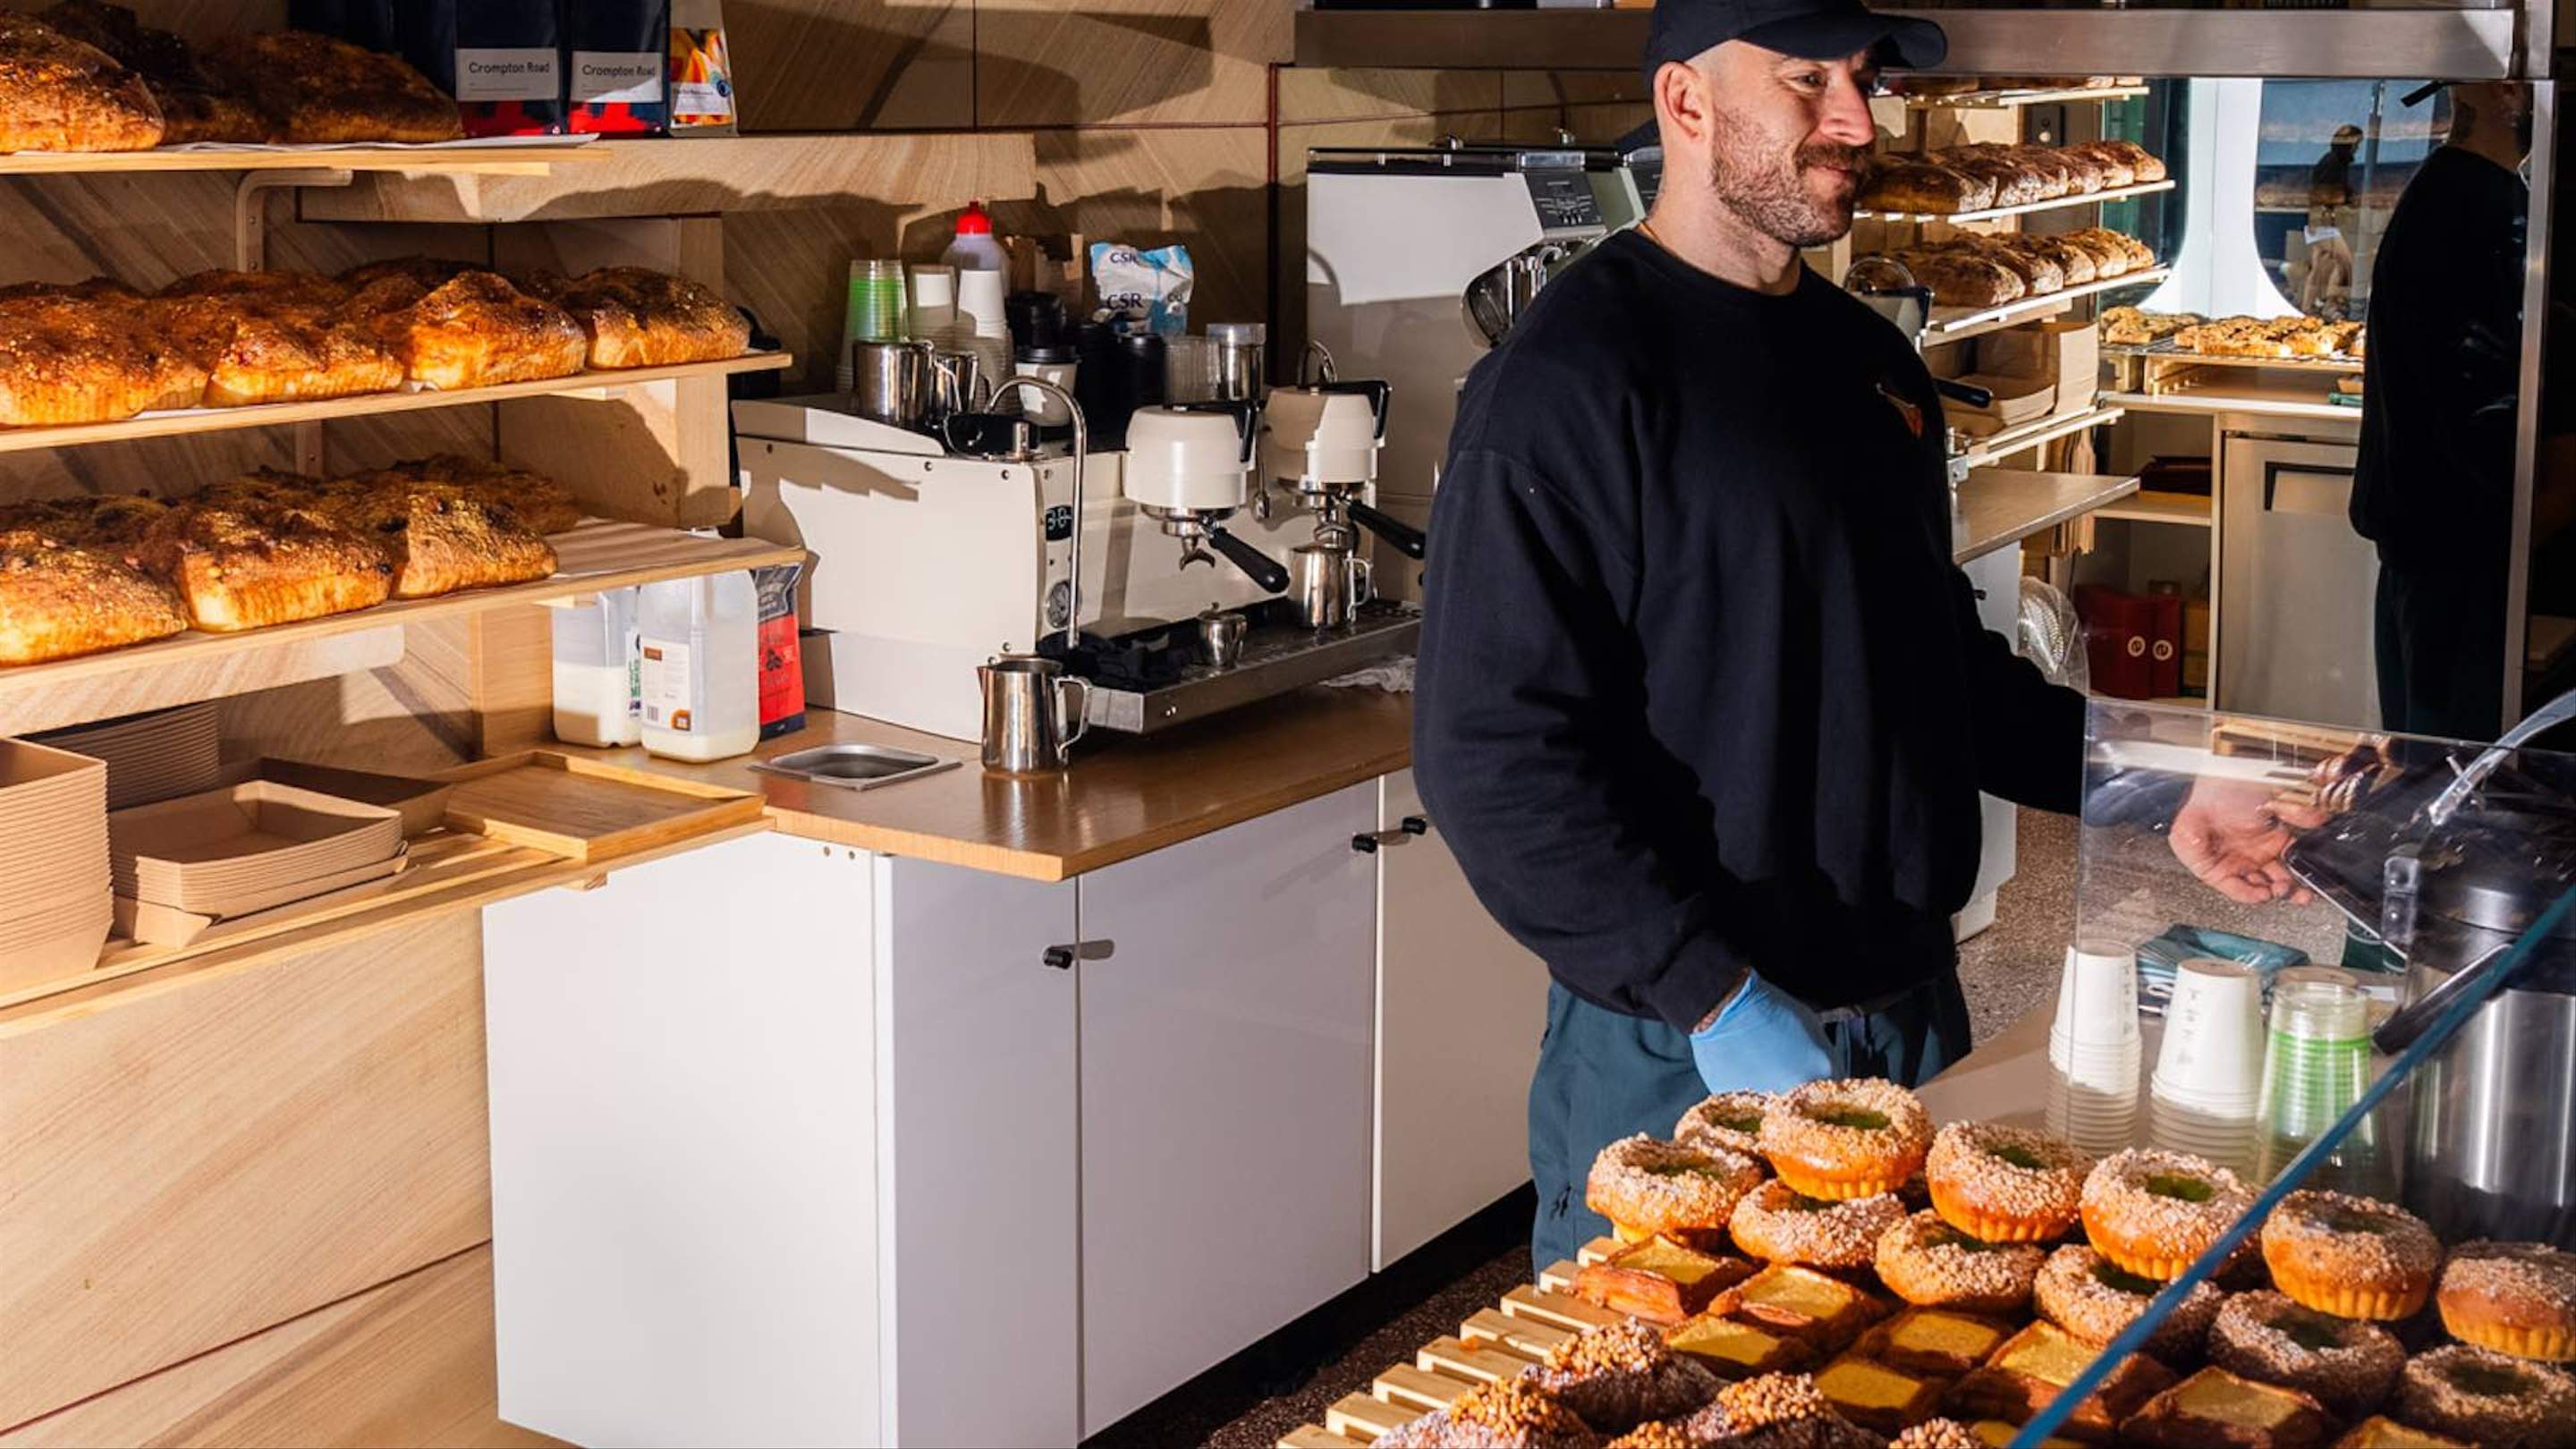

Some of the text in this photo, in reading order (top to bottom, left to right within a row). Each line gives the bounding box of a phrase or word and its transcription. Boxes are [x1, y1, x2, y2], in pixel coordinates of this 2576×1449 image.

[468, 60, 550, 75] Crompton Road
[581, 64, 656, 79] Crompton Road
[1106, 292, 1144, 310] CSR
